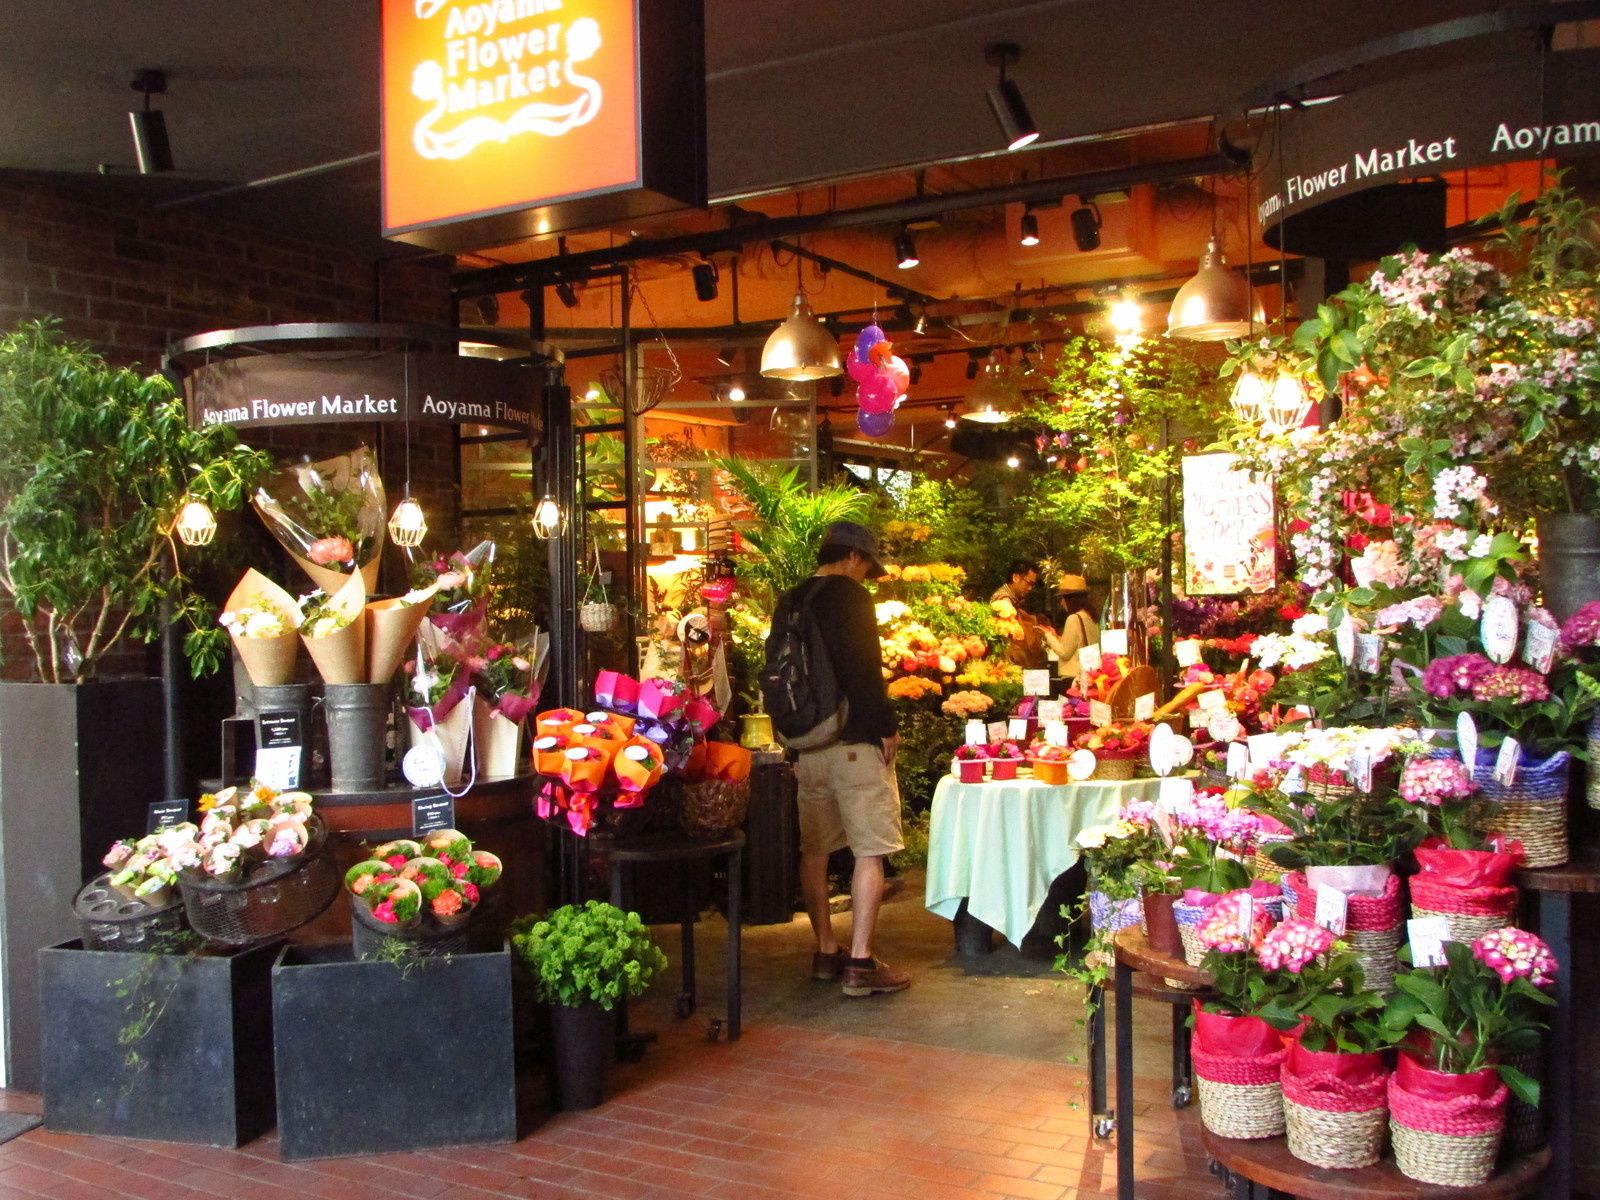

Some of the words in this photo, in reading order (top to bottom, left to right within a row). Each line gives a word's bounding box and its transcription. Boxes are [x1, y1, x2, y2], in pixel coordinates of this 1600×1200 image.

[445, 22, 562, 77] Flower
[446, 59, 562, 113] Market
[1287, 163, 1348, 205] Flower
[1355, 137, 1457, 179] Market
[202, 406, 250, 426] Aoyama
[252, 398, 316, 420] Flower
[321, 394, 398, 415] Market
[422, 395, 491, 419] Aoyama
[495, 400, 530, 425] Flower
